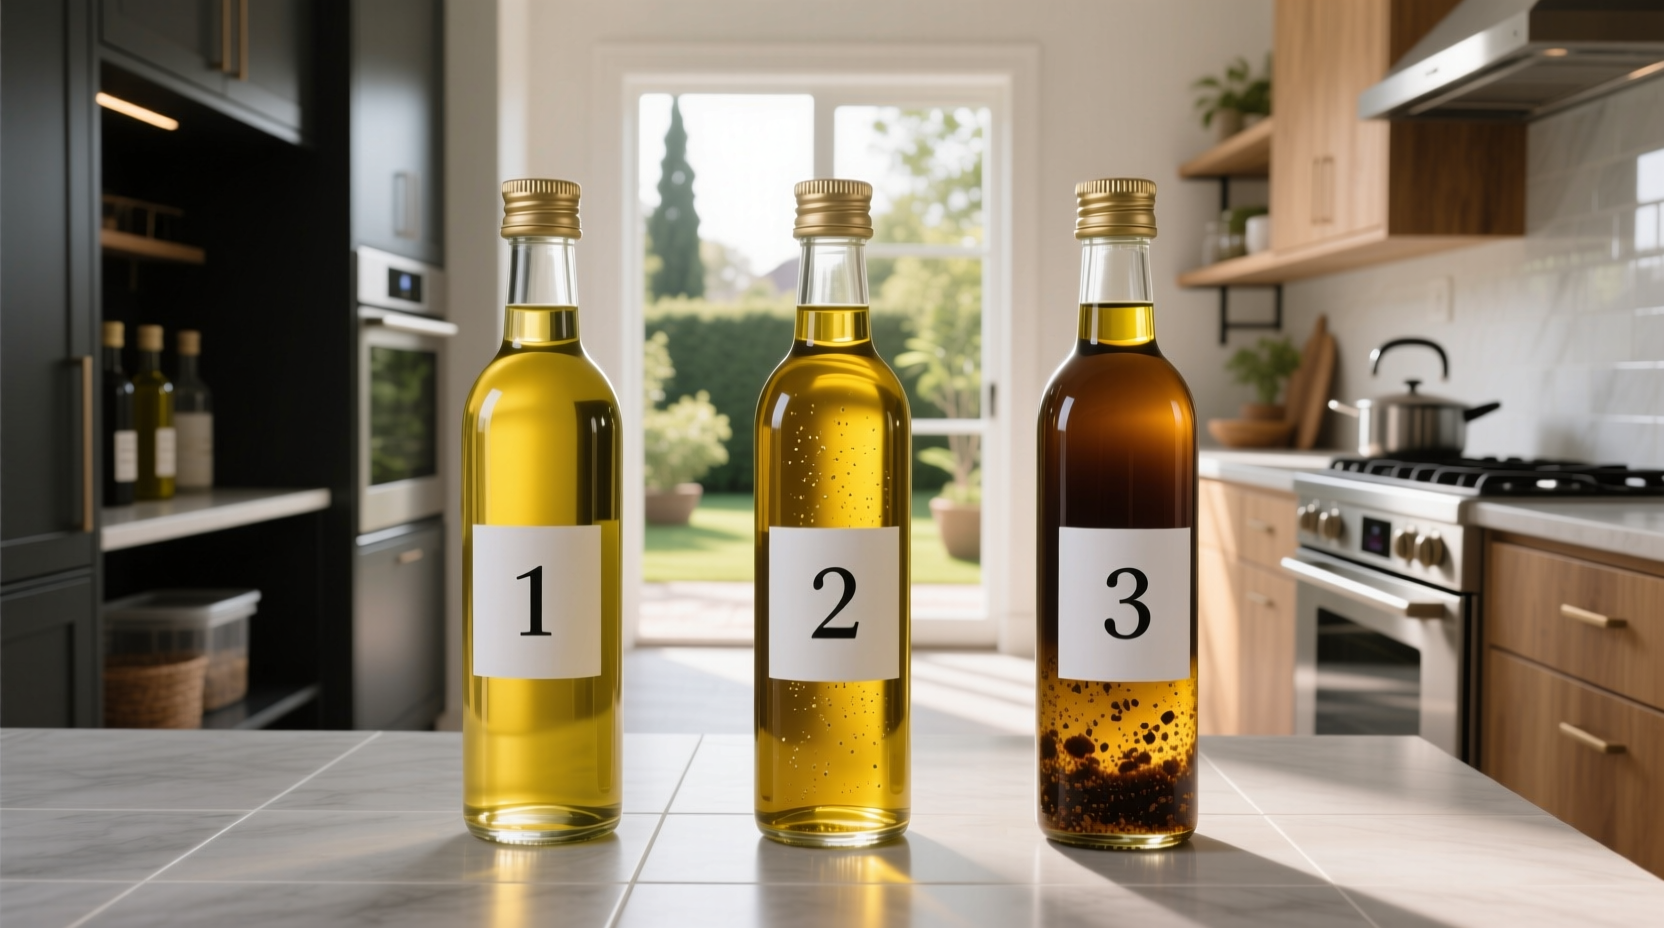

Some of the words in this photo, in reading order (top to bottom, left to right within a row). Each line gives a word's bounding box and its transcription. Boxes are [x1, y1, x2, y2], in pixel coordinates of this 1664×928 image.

[516, 565, 552, 637] 1
[811, 566, 860, 640] 2
[1103, 567, 1151, 640] 3
